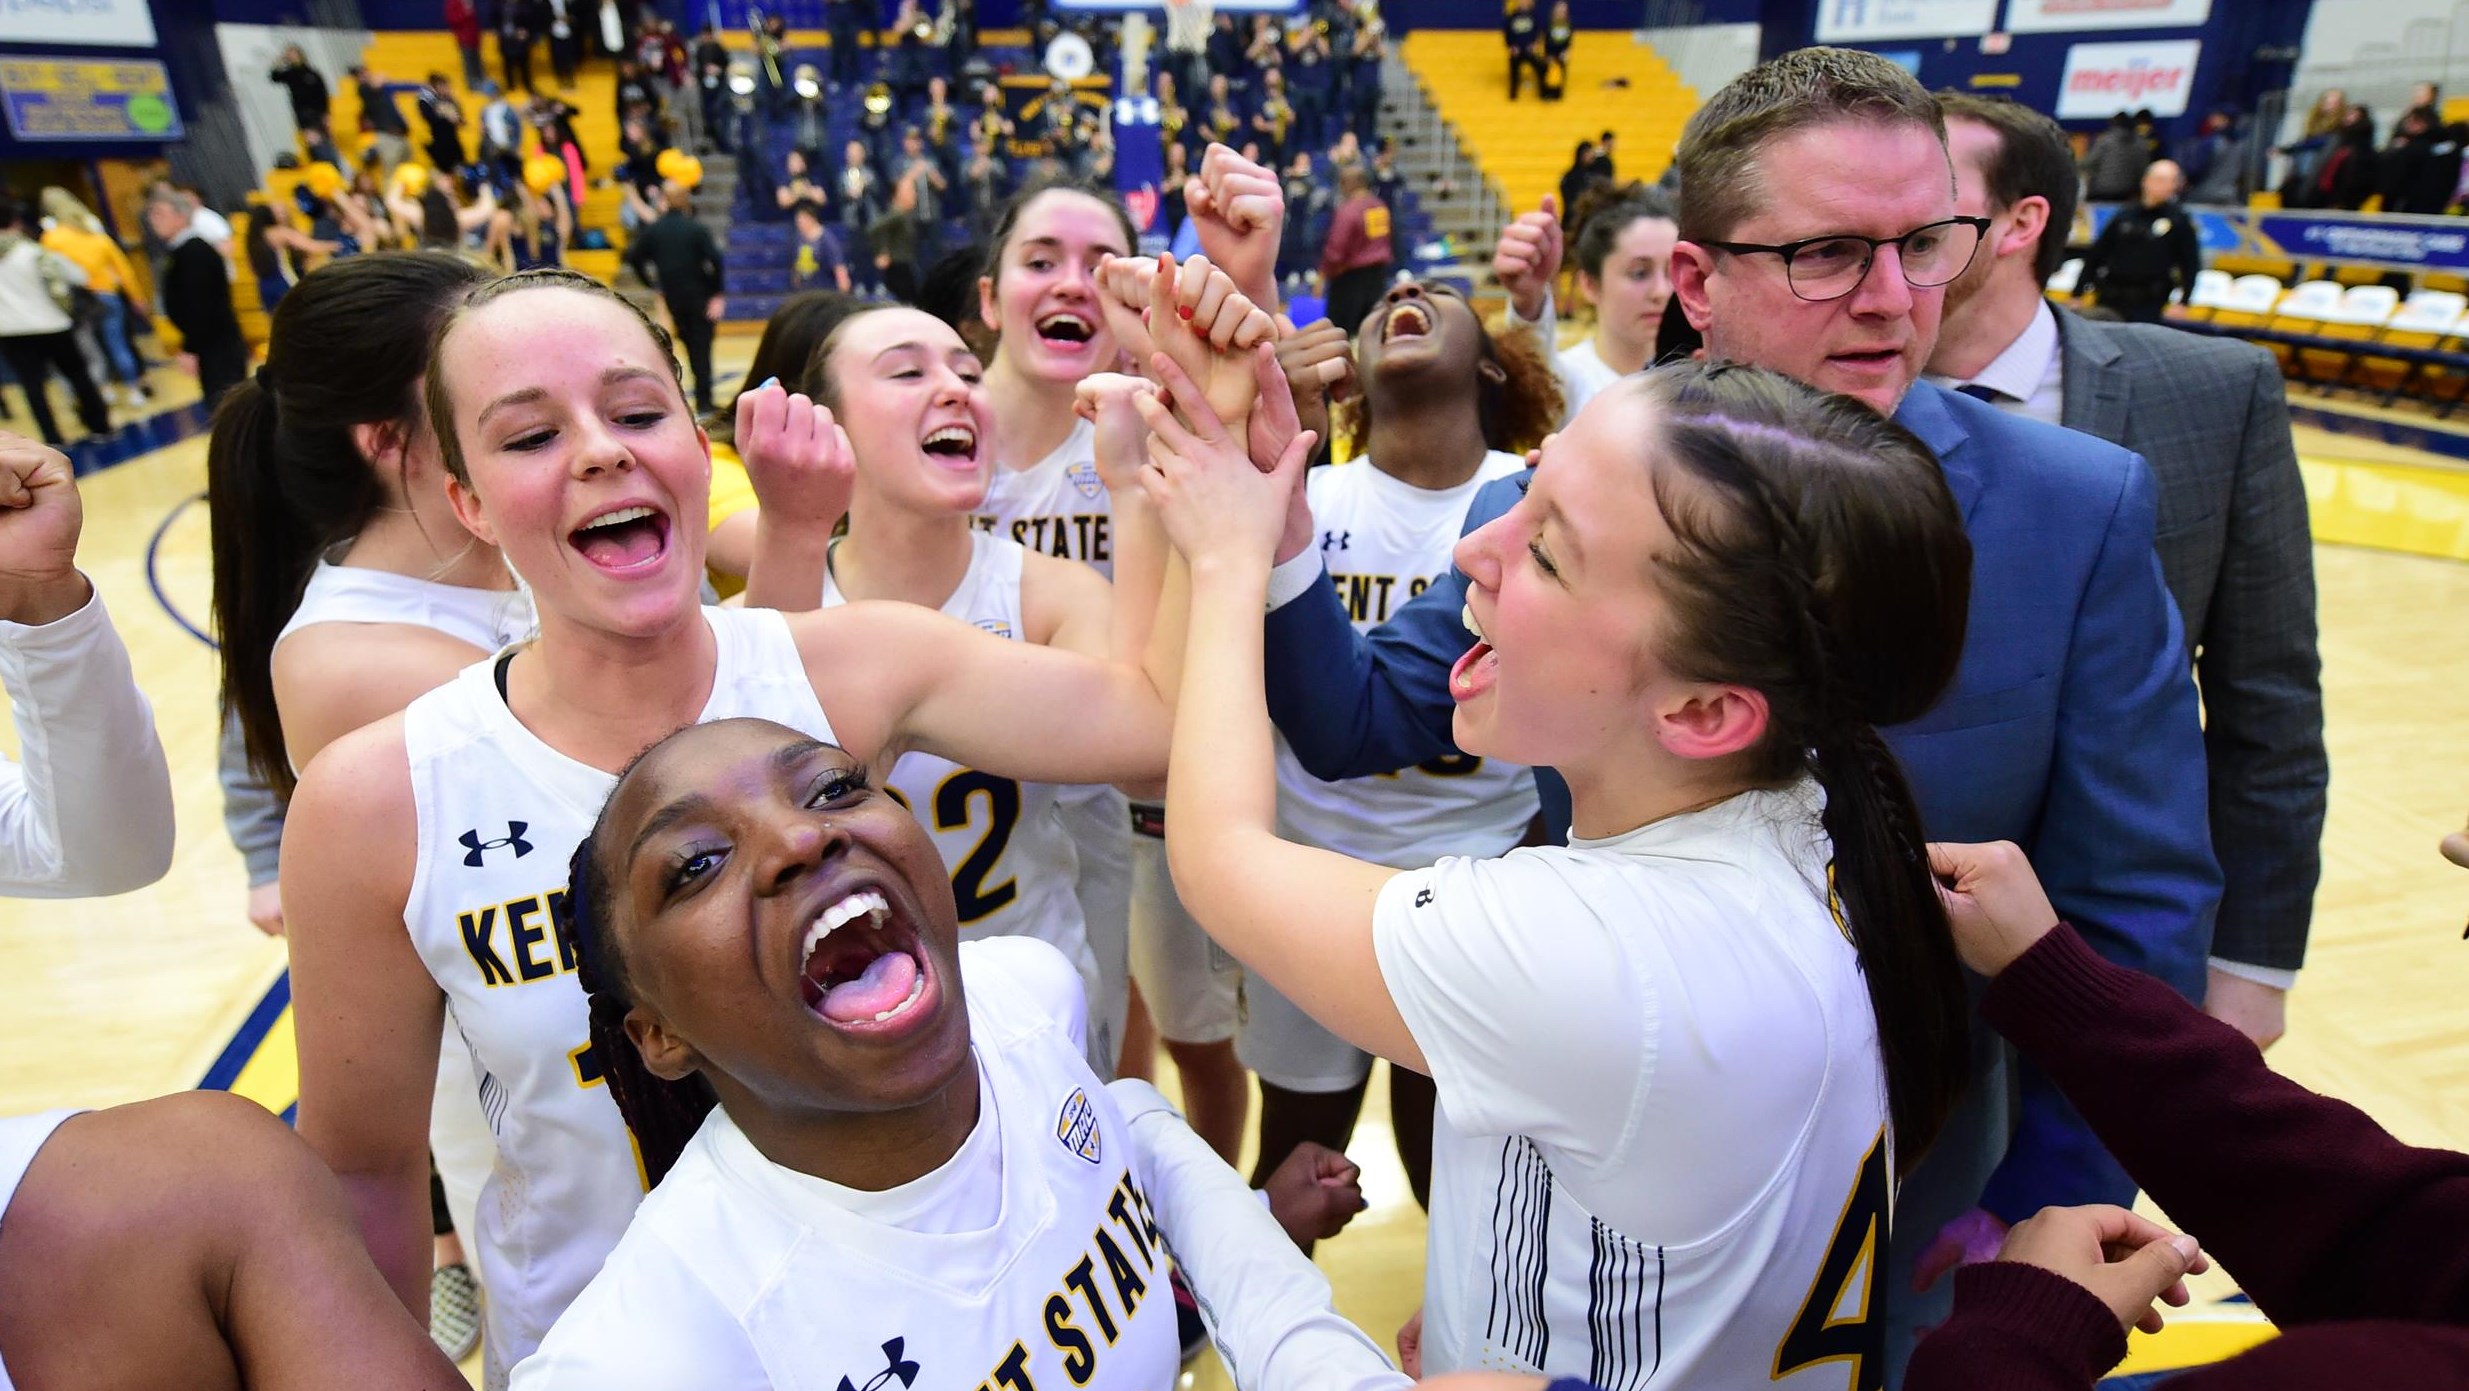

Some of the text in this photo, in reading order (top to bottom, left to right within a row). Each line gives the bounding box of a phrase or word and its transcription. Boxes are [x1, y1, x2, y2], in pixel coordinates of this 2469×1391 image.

[2069, 57, 2184, 101] meijer
[1011, 513, 1109, 562] STATE
[1042, 1167, 1160, 1389] STATE
